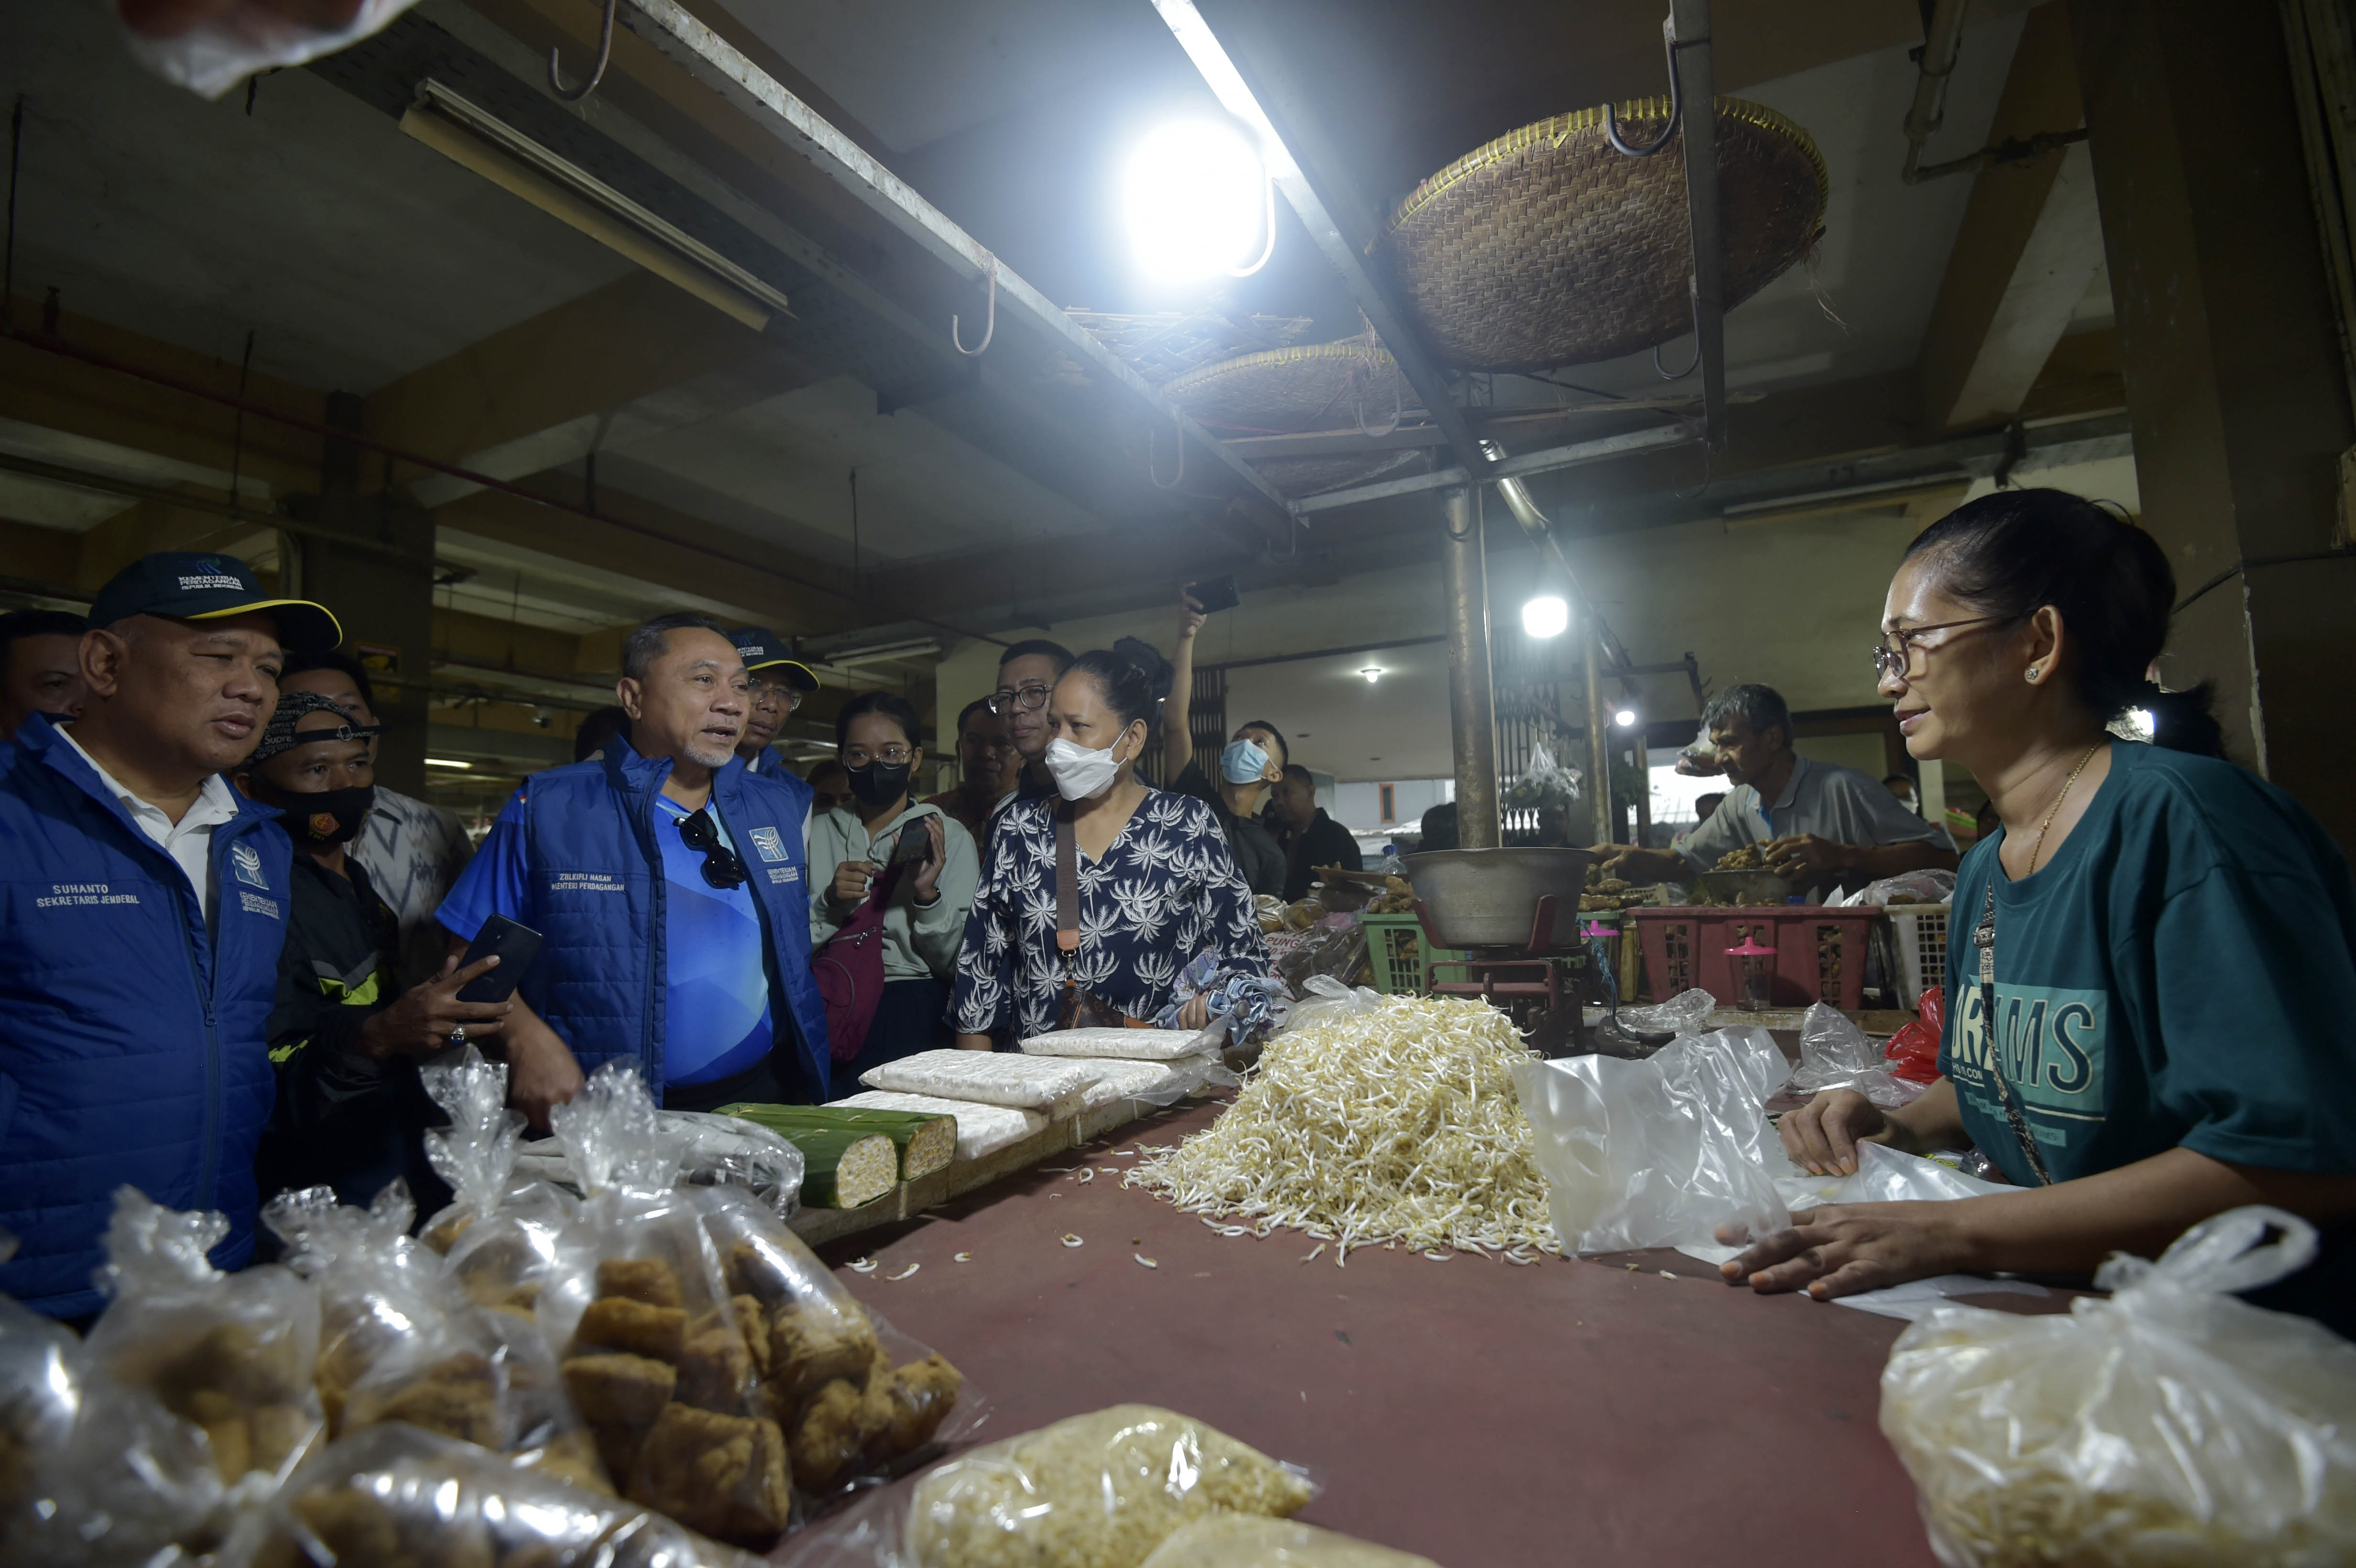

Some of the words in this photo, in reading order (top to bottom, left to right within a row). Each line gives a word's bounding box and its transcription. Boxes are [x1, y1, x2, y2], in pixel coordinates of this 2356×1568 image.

[53, 884, 109, 894] SUHANTO
[551, 882, 578, 890] MENTERI
[579, 882, 624, 891] PERDAGANGAN
[37, 895, 99, 907] SEKRETARIS
[101, 894, 140, 904] JENDERAL
